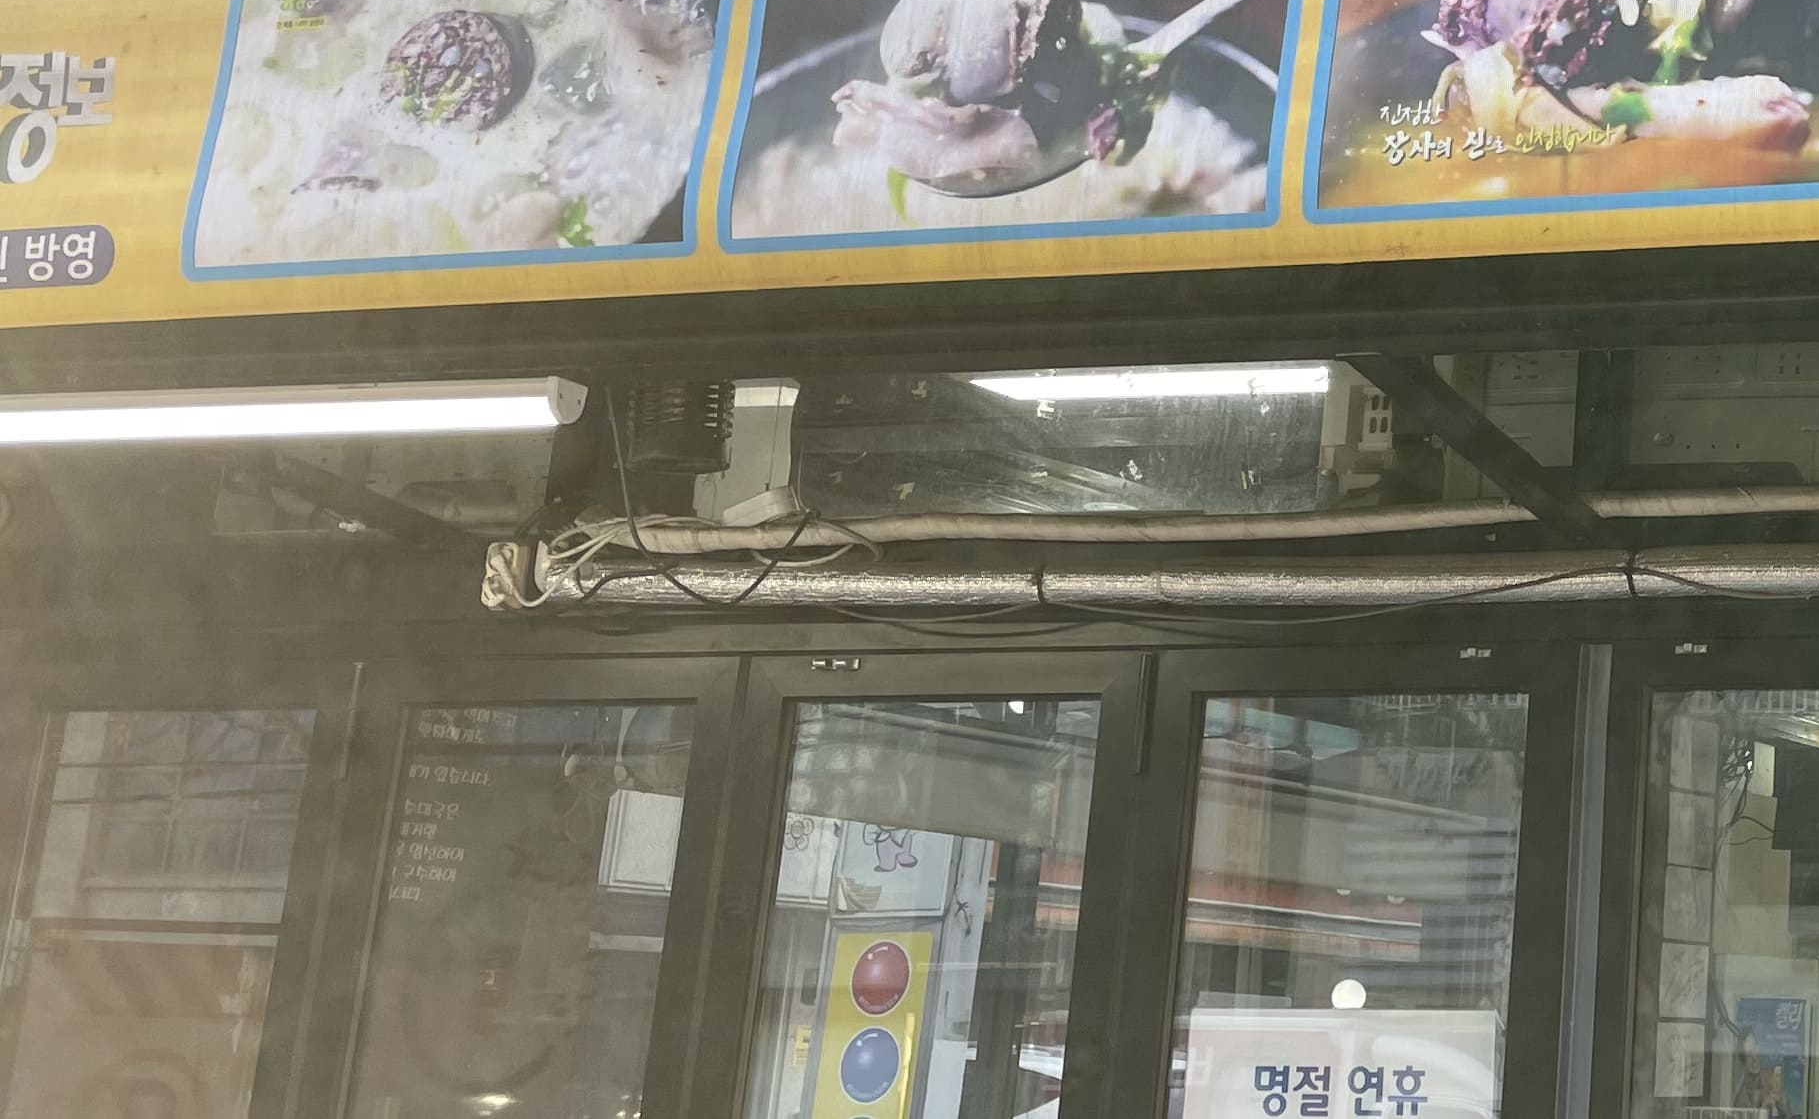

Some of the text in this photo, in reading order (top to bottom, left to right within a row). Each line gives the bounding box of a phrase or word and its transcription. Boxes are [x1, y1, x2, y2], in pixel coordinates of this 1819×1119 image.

[0, 51, 116, 183] 정보
[1380, 99, 1446, 127] 진정한
[1382, 130, 1454, 166] 장사의
[1462, 127, 1508, 161] 신으로
[24, 230, 96, 282] 방영
[1253, 1064, 1429, 1117] 명절 연휴
